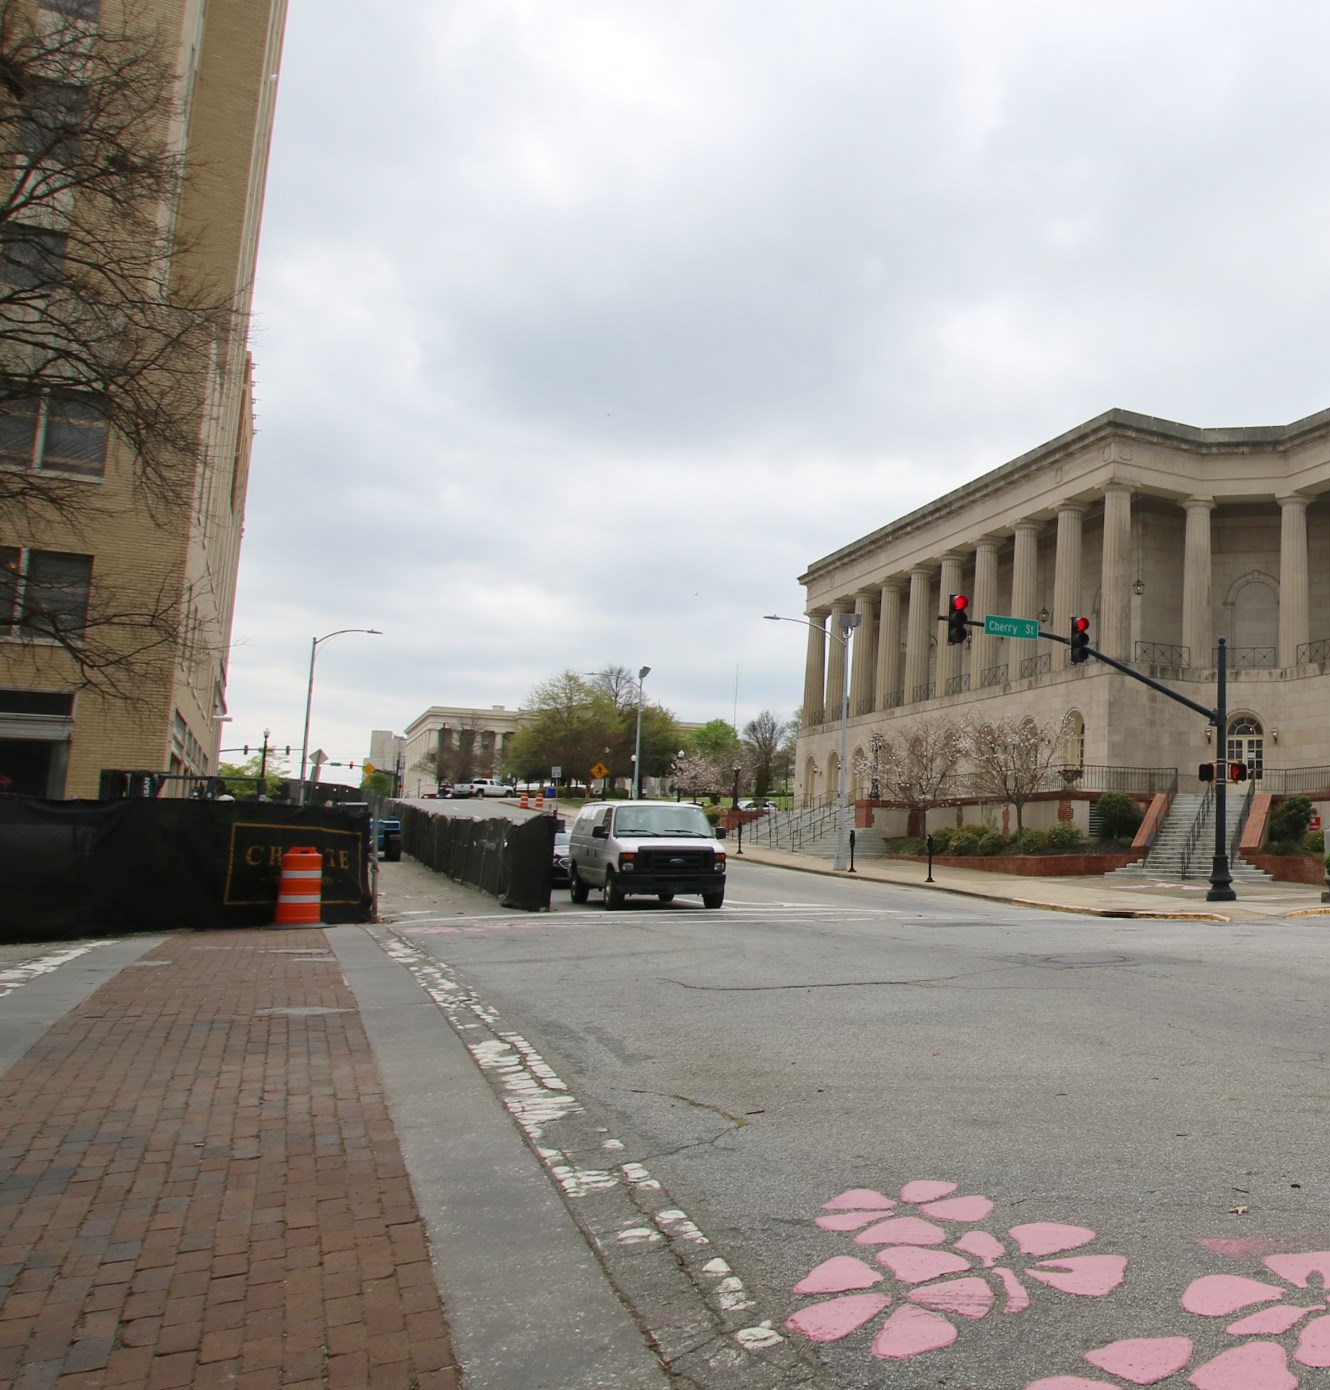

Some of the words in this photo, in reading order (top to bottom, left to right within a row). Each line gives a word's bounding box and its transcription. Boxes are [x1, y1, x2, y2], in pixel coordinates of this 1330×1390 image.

[989, 620, 1018, 635] Cherry
[1025, 624, 1034, 635] St
[245, 843, 350, 868] CHTE
